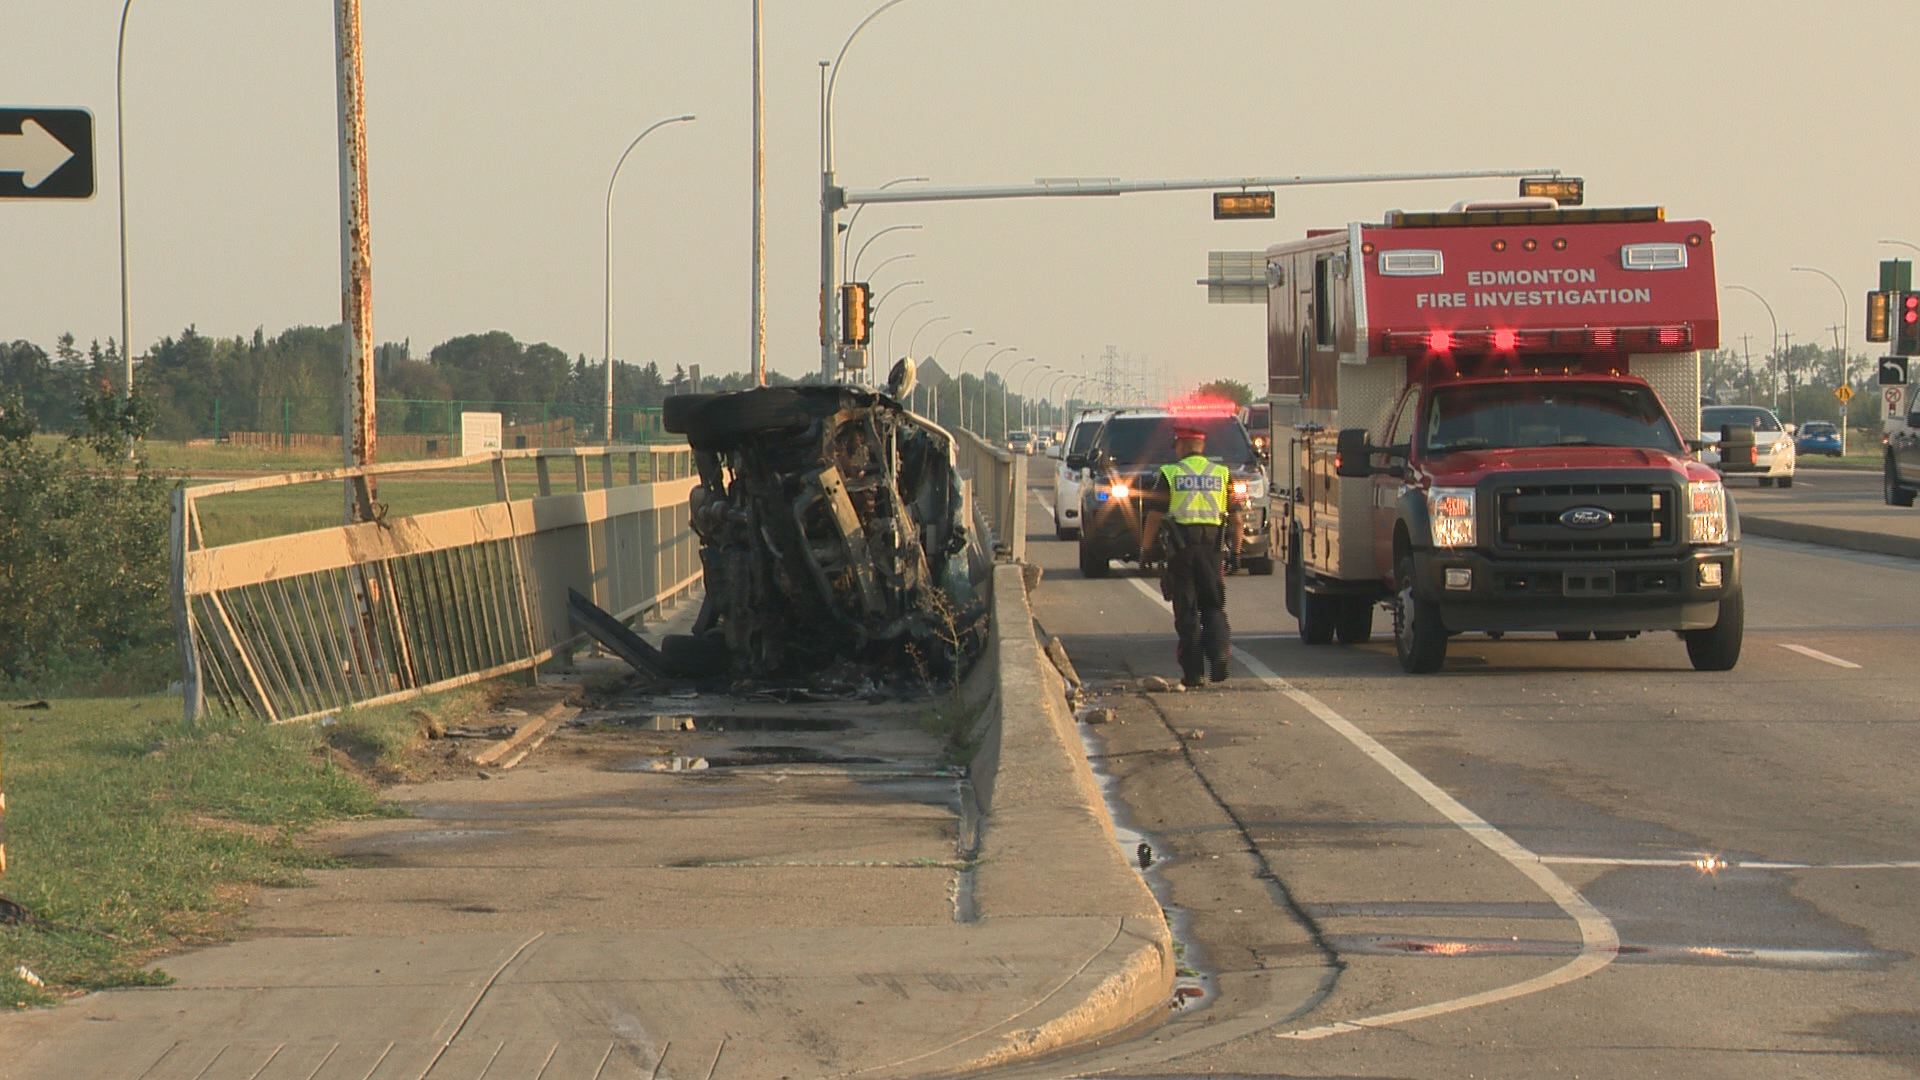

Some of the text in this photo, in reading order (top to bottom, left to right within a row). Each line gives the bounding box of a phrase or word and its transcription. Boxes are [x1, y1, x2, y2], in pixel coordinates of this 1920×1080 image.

[1467, 268, 1596, 286] EDMONTON
[1416, 288, 1651, 308] FIRE INVESTIGATION
[1175, 476, 1221, 490] POLICE
[1572, 511, 1601, 524] Ford
